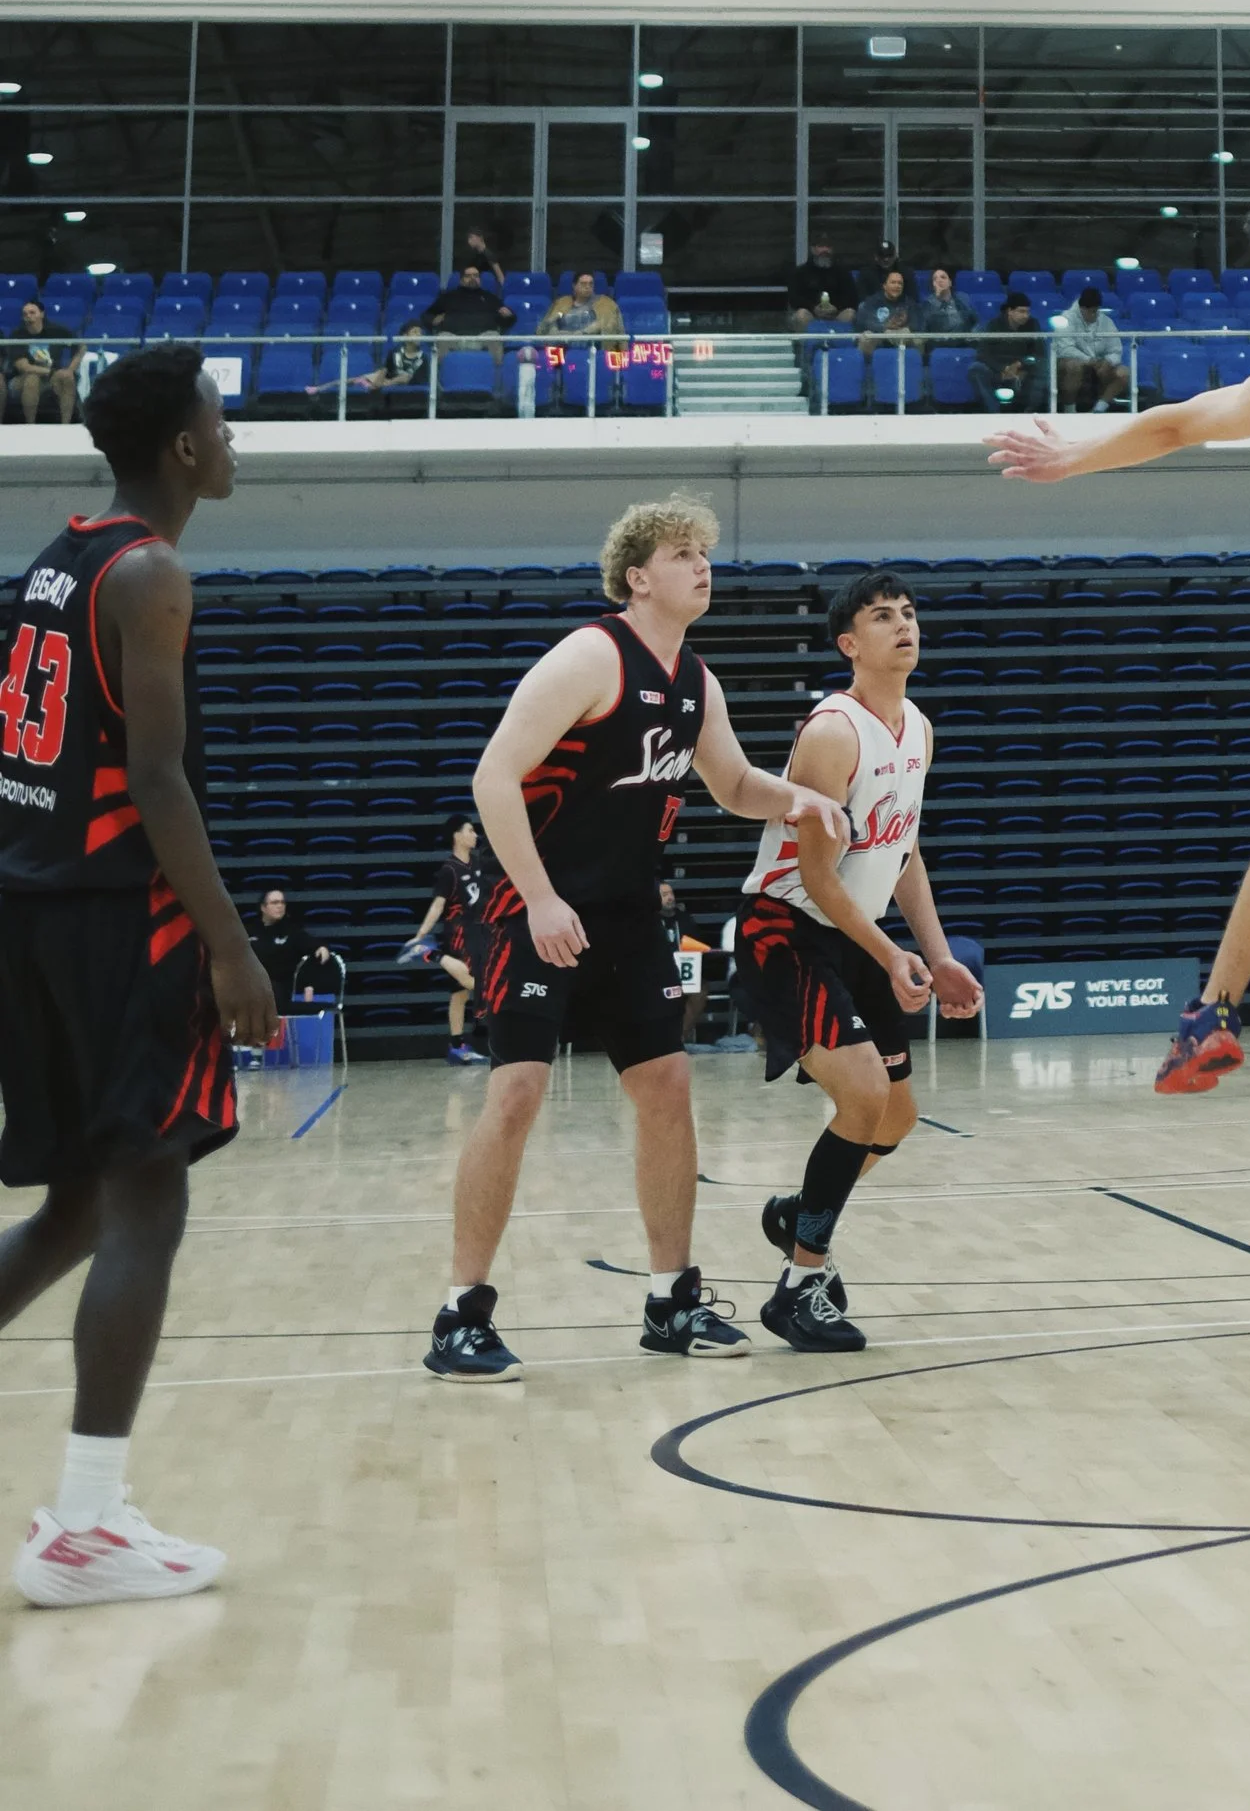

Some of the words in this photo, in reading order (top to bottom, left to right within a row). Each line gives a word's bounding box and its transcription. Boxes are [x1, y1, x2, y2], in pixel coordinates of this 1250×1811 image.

[0, 623, 72, 766] 43
[681, 962, 694, 981] B
[520, 982, 548, 998] SAS
[1086, 980, 1131, 993] WE'VE
[1134, 978, 1165, 991] GOT
[1009, 981, 1076, 1019] SAS
[1087, 996, 1126, 1008] YOUR
[1130, 993, 1169, 1007] BACK
